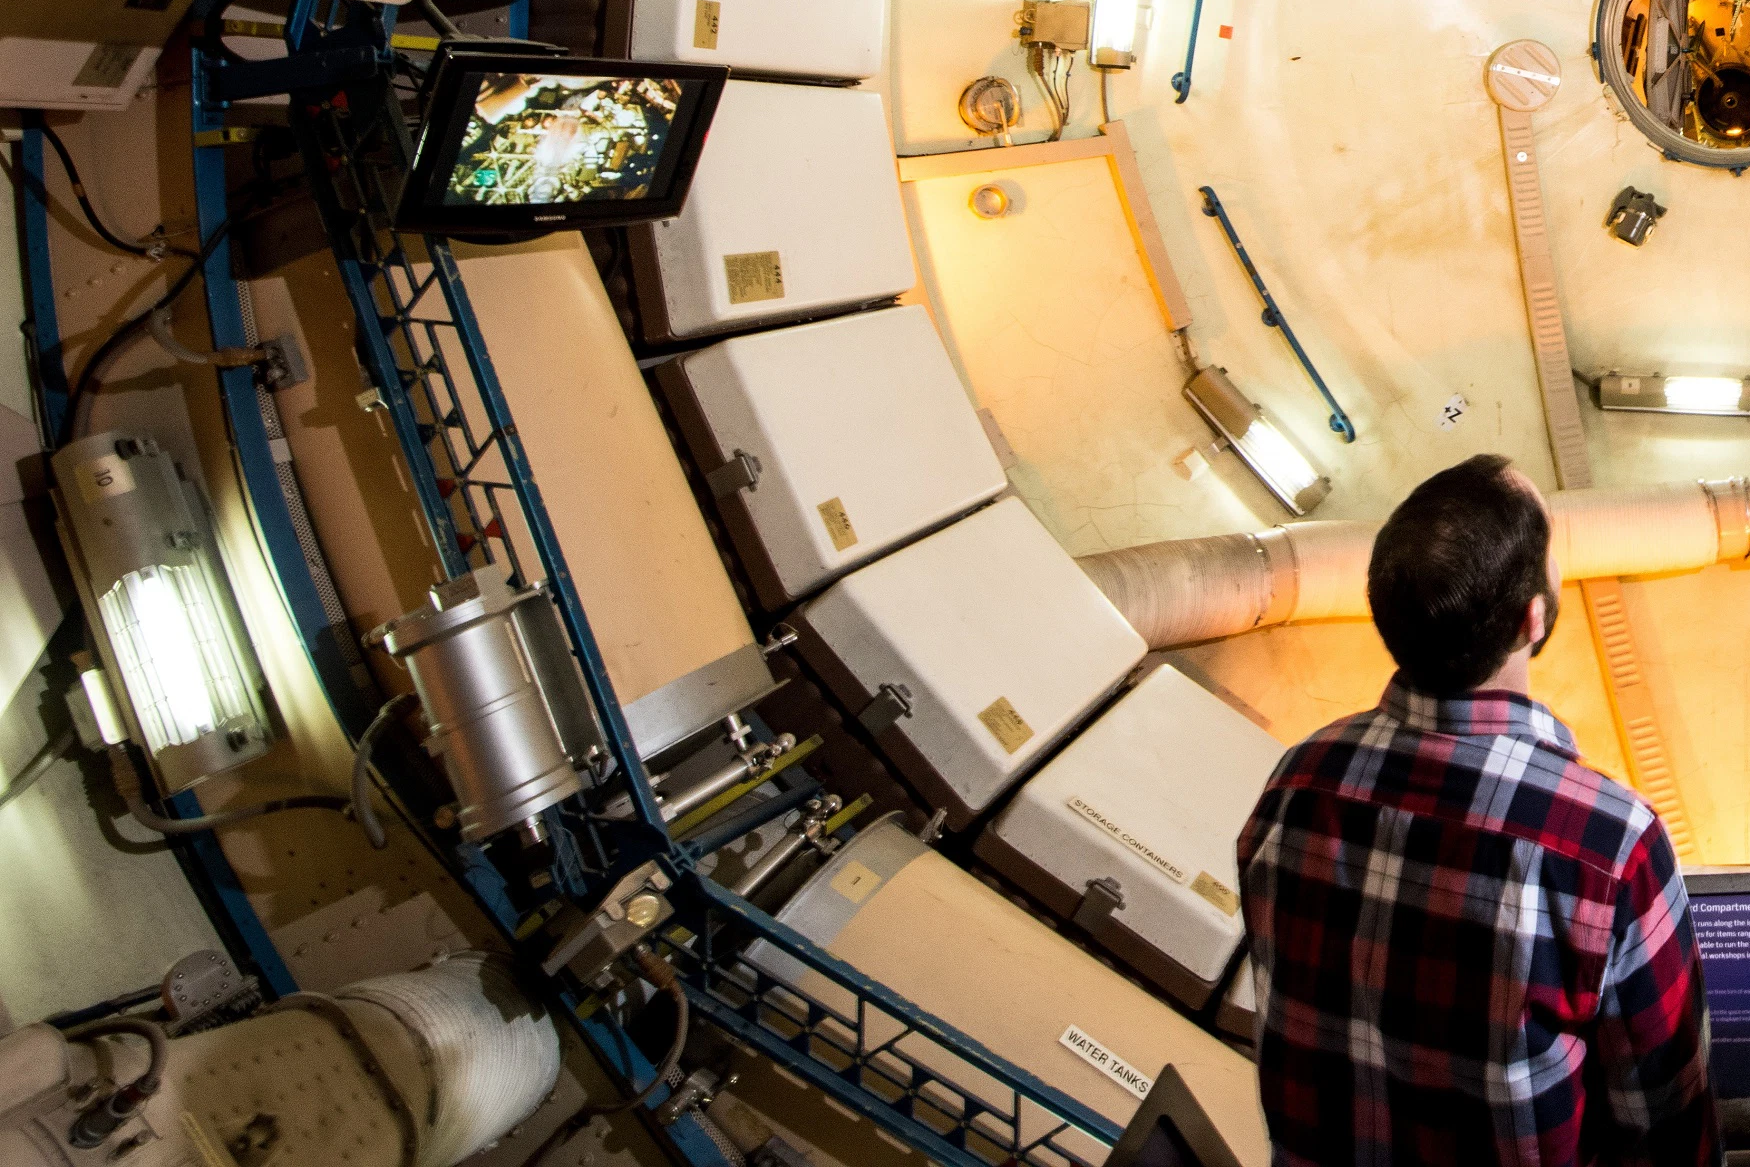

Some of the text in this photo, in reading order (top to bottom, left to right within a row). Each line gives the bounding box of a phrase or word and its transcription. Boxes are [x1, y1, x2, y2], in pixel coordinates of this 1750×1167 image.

[710, 16, 719, 34] 442
[774, 264, 783, 284] 444
[1075, 800, 1184, 878] STORAGE CONTAINERS
[1714, 920, 1733, 928] along
[1709, 952, 1745, 960] workshops
[1068, 1030, 1149, 1093] WATER TANKS
